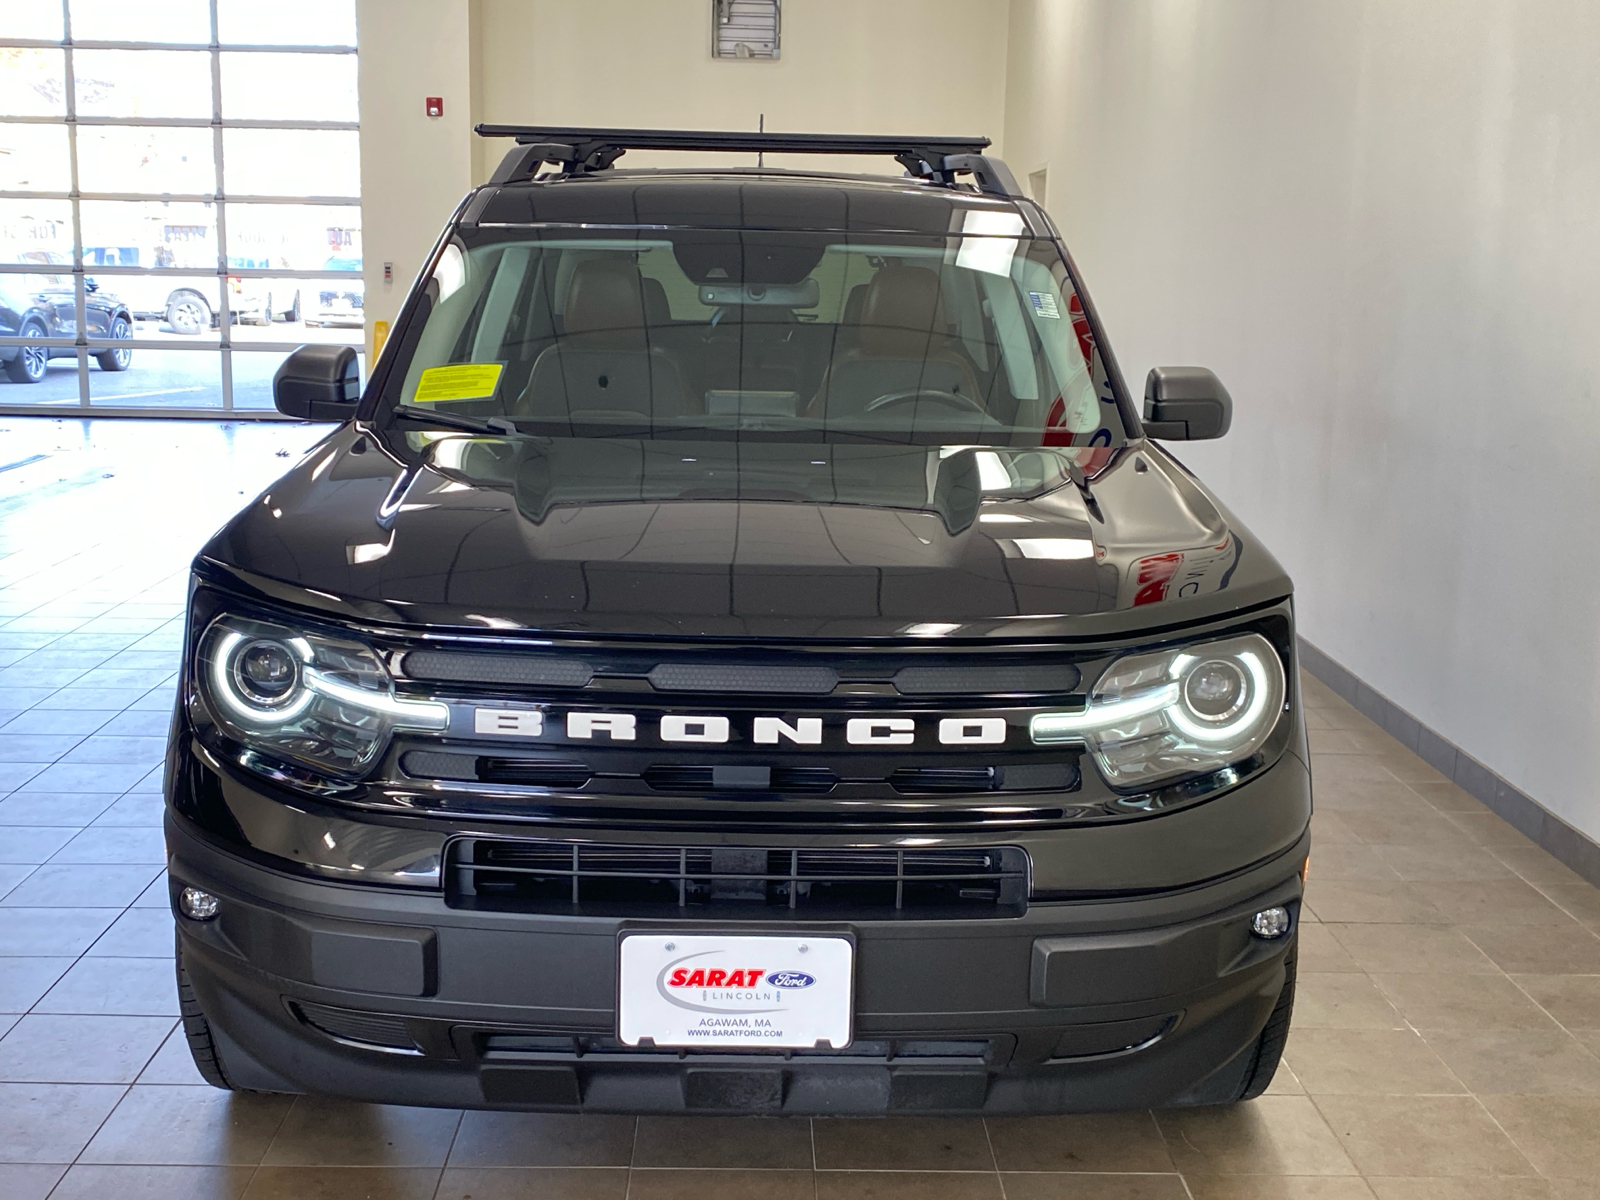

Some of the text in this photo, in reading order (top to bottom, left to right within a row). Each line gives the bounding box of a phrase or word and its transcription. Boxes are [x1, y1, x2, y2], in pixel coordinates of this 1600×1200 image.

[474, 707, 1007, 745] BRONCO
[667, 967, 808, 988] SARAT Ford
[712, 991, 771, 1000] LINCOLN
[699, 1018, 772, 1029] AGAWAM, MA
[687, 1029, 783, 1038] WWW.SARATFORD.COM
